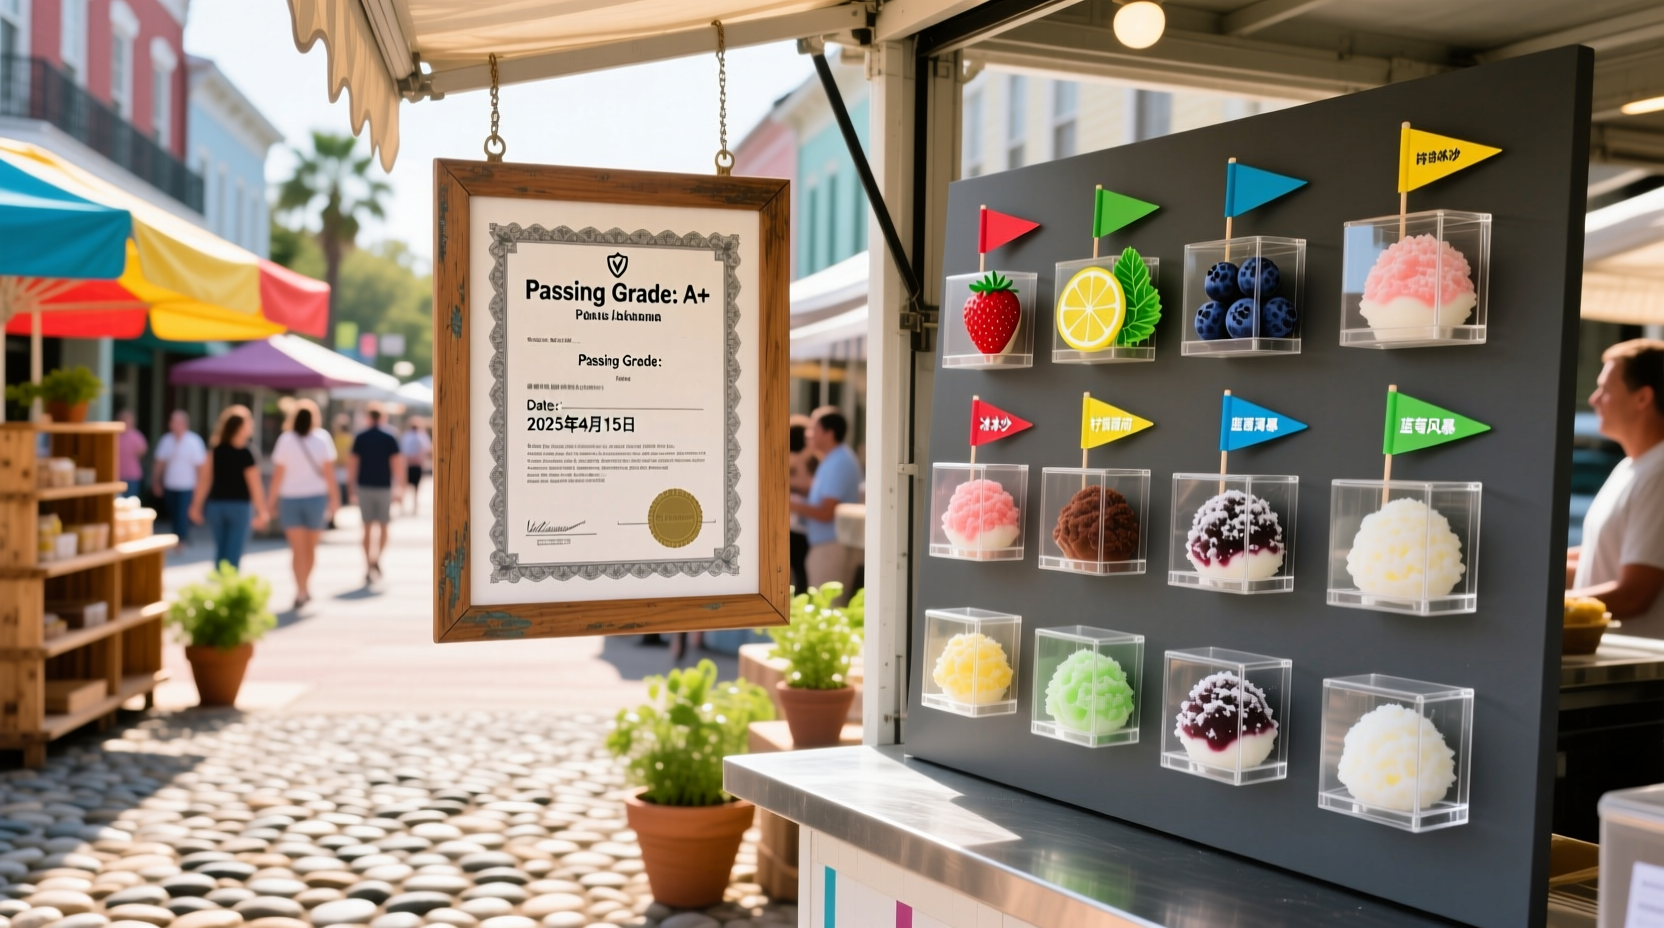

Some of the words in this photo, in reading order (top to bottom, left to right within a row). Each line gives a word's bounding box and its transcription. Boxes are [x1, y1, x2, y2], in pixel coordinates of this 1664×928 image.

[526, 280, 605, 307] Passing
[612, 283, 678, 304] Grade:
[683, 285, 710, 304] A+
[578, 354, 619, 369] Passing
[623, 355, 662, 367] Grade:
[527, 399, 559, 411] Date:
[527, 415, 635, 433] 2025年4月15日
